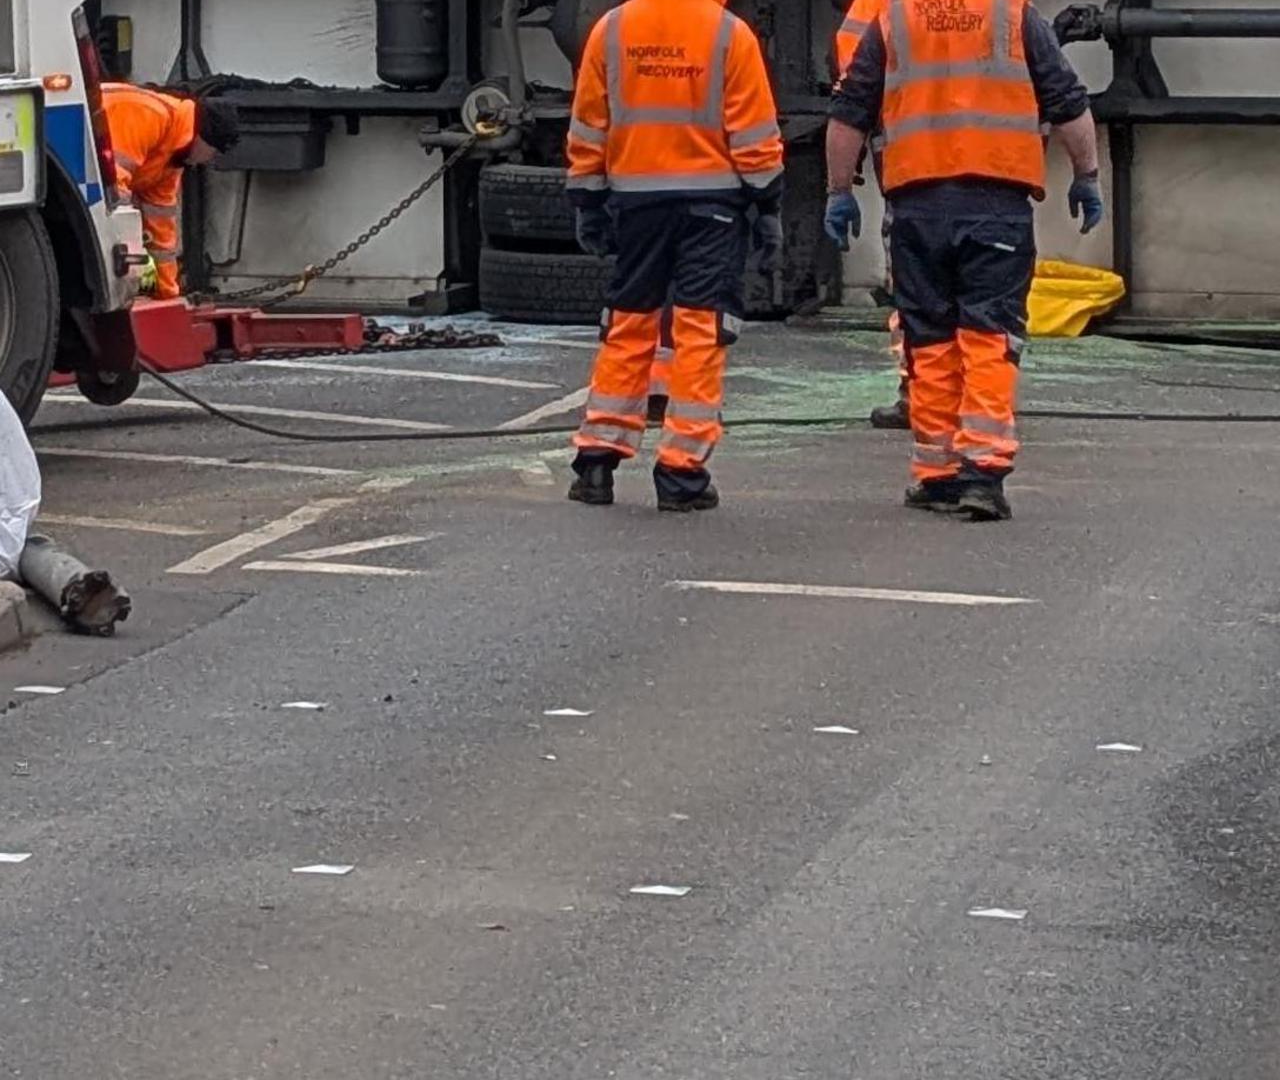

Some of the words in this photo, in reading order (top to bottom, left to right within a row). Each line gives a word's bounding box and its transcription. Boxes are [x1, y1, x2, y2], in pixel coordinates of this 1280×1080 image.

[926, 12, 985, 32] RECOVERY
[626, 45, 687, 59] NORFOLK
[636, 64, 704, 79] RECOVERY
